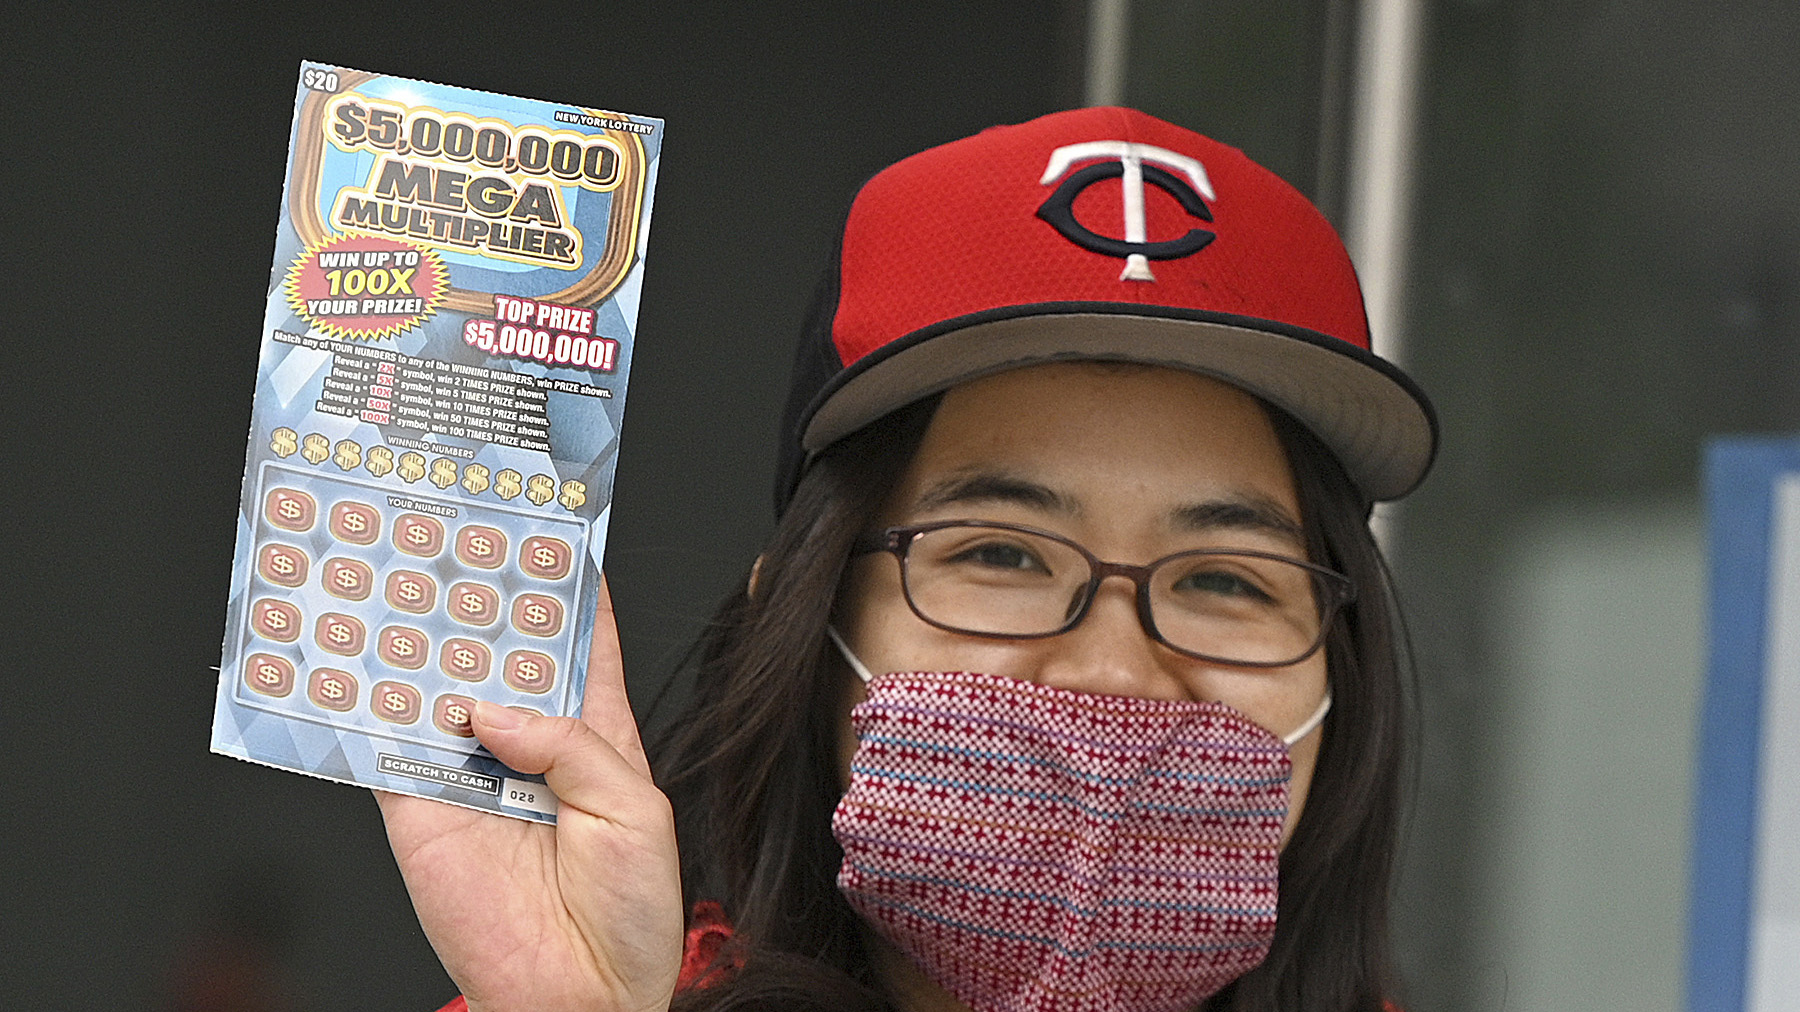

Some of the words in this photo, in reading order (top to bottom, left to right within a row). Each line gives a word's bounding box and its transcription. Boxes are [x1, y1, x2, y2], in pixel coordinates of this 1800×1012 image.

[304, 70, 338, 92] $20
[556, 112, 580, 122] NEW
[580, 116, 607, 128] YORK
[608, 120, 654, 134] LOTTERY
[335, 103, 618, 184] $5,000,000
[376, 160, 560, 227] MEGA
[340, 197, 574, 263] MULTIPLIER
[320, 252, 360, 268] WIN
[364, 252, 390, 267] UP
[394, 251, 419, 266] TO
[326, 268, 416, 296] 100X
[307, 300, 358, 315] YOUR
[361, 298, 422, 314] PRIZE!
[496, 298, 534, 324] TOP
[536, 304, 592, 334] PRIZE
[274, 331, 300, 344] Match
[302, 338, 318, 349] any
[319, 339, 329, 349] of
[330, 342, 353, 354] YOUR
[354, 346, 397, 362] NUMBERS
[398, 354, 406, 364] to
[408, 357, 424, 368] any
[425, 358, 434, 368] of
[436, 360, 450, 371] the
[452, 364, 489, 378] WINNING
[491, 370, 535, 387] NUMBERS,
[537, 378, 552, 389] win
[554, 382, 579, 393] PRIZE
[580, 386, 612, 398] shown.
[465, 321, 615, 369] $5,000,000!
[332, 368, 360, 380] Reveal
[362, 374, 368, 382] a
[401, 381, 433, 394] symbol,
[436, 387, 451, 396] win
[453, 390, 458, 398] 5
[461, 391, 486, 403] TIMES
[488, 396, 513, 408] PRIZE
[514, 401, 544, 412] shown.
[334, 355, 362, 368] Reveal
[364, 362, 370, 370] a
[402, 368, 436, 381] symbol,
[438, 374, 452, 384] win
[454, 378, 460, 386] 2
[462, 378, 488, 390] TIMES
[490, 384, 514, 396] PRIZE
[516, 388, 548, 400] shown.
[323, 391, 352, 404] Reveal
[398, 406, 431, 419] symbol,
[434, 412, 448, 421] win
[450, 415, 462, 424] 50
[464, 416, 490, 428] TIMES
[492, 422, 516, 434] PRIZE
[518, 426, 548, 438] shown.
[325, 378, 354, 391] Reveal
[400, 394, 433, 407] symbol,
[436, 400, 450, 410] win
[453, 402, 462, 411] 10
[465, 404, 491, 416] TIMES
[492, 409, 517, 420] PRIZE
[519, 414, 550, 426] shown.
[316, 402, 345, 415] Reveal
[346, 408, 352, 416] a
[396, 418, 430, 432] symbol,
[432, 424, 447, 434] win
[450, 428, 464, 437] 100
[467, 430, 492, 442] TIMES
[494, 435, 518, 447] PRIZE
[520, 440, 550, 452] shown.
[388, 436, 430, 450] WINNING
[431, 445, 474, 459] NUMBERS
[388, 498, 412, 509] YOUR
[414, 502, 457, 517] NUMBERS
[384, 760, 439, 778] SCRATCH
[442, 770, 458, 782] TO
[460, 775, 492, 789] CASH
[510, 790, 535, 802] 028
